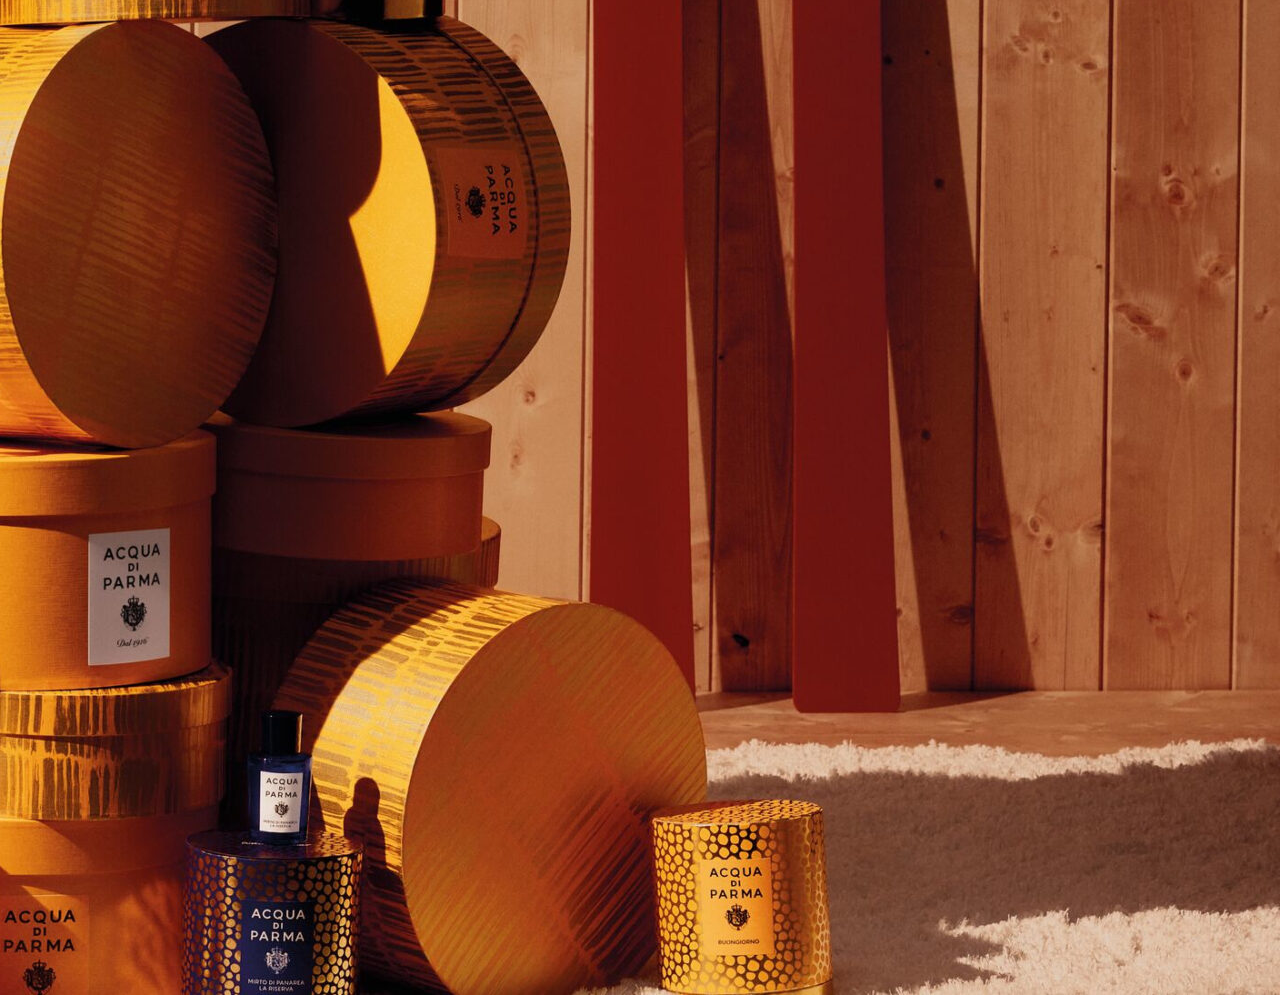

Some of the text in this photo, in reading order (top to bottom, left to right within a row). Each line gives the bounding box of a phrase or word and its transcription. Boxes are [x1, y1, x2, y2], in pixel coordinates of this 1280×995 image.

[485, 165, 500, 235] PARMA
[499, 192, 506, 205] DI
[501, 164, 518, 233] ACQUA
[103, 543, 160, 561] ACQUA
[128, 562, 139, 572] DI
[103, 572, 160, 590] PARMA
[266, 777, 298, 786] ACQUA
[709, 866, 762, 878] ACQUA
[710, 888, 763, 899] PARMA
[4, 909, 76, 925] ACQUA
[251, 908, 306, 920] ACQUA
[33, 927, 47, 936] DI
[273, 922, 284, 930] DI
[250, 930, 305, 942] PARMA
[3, 939, 75, 952] PARMA
